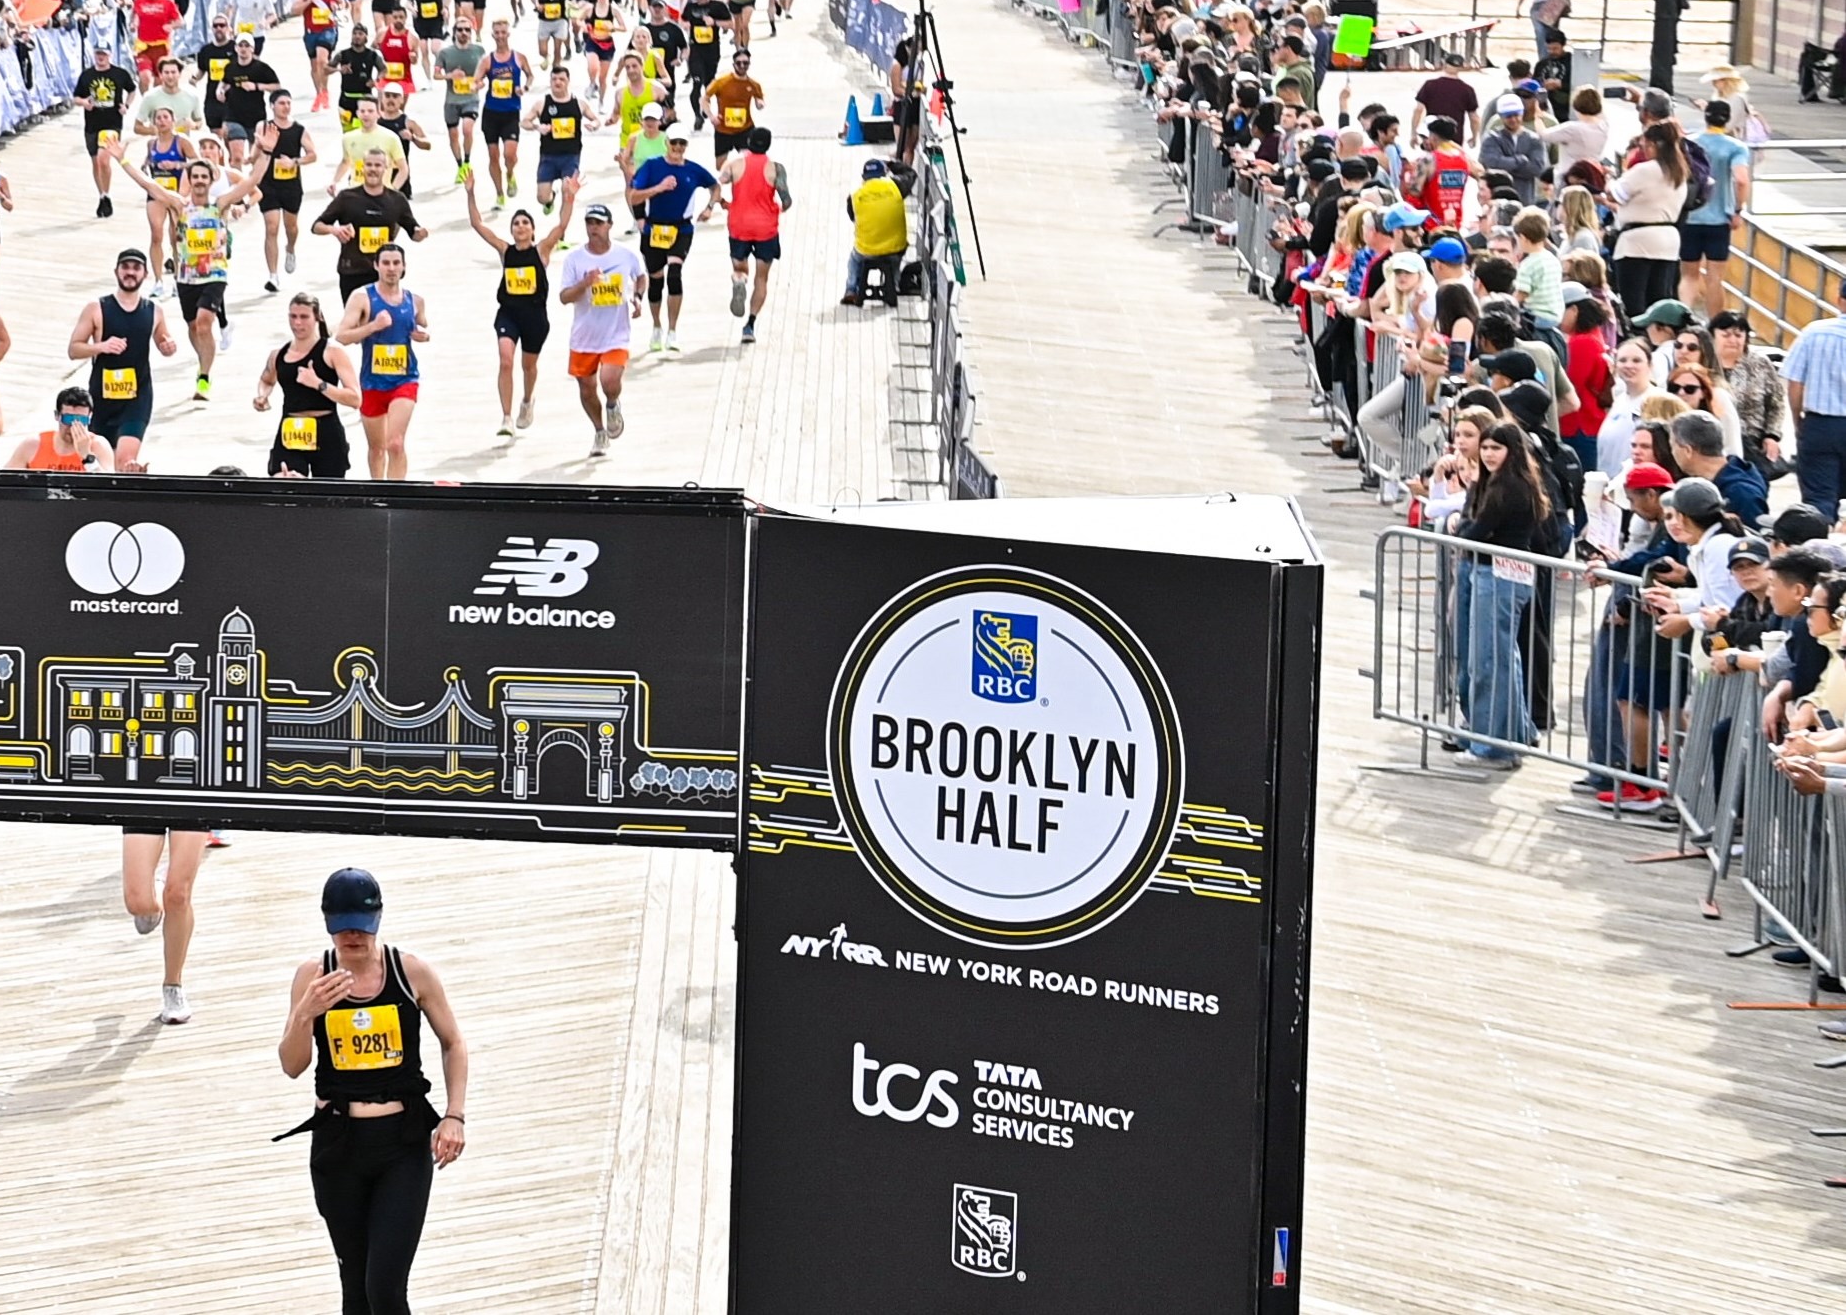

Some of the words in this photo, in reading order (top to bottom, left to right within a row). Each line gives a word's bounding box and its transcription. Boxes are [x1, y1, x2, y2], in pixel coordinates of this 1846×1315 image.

[473, 536, 600, 597] NB
[69, 597, 180, 615] mastercard
[449, 604, 501, 626] new
[507, 603, 616, 630] balance
[978, 675, 1032, 700] RBC
[871, 713, 1137, 800] BROOKLYN
[935, 786, 1064, 853] HALF
[781, 934, 888, 968] NYRR
[896, 950, 950, 976] NEW
[958, 959, 1022, 987] YORK
[1029, 969, 1097, 997] ROAD
[1105, 980, 1219, 1016] RUNNERS
[333, 1038, 343, 1054] F
[352, 1033, 391, 1055] 9281
[852, 1042, 959, 1128] tcs
[973, 1059, 1042, 1090] TATA
[973, 1086, 1134, 1132] CONSULTANCY
[972, 1113, 1074, 1148] SERVICES
[960, 1245, 1008, 1271] RBC
